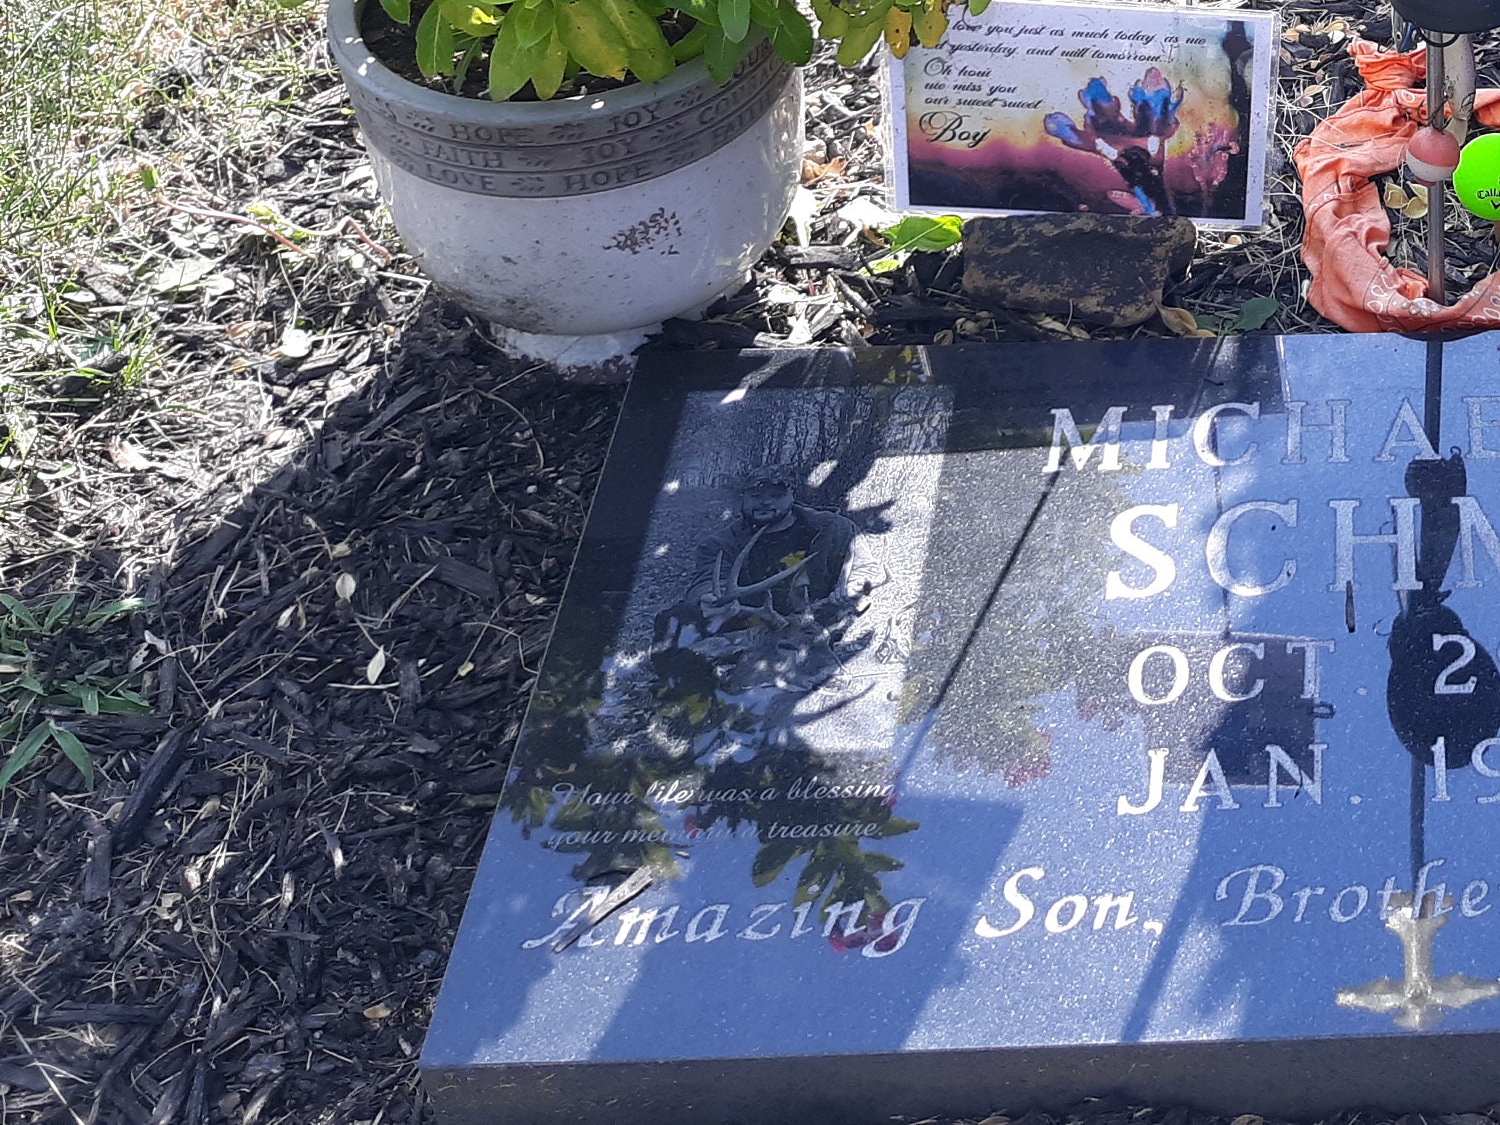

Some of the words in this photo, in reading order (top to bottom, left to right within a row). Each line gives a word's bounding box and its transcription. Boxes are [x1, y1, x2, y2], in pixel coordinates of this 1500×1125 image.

[985, 24, 1014, 36] you
[1012, 25, 1047, 37] just
[1049, 27, 1064, 37] as
[1071, 28, 1110, 40] much
[1163, 36, 1180, 44] as
[1185, 37, 1207, 45] we
[923, 57, 952, 76] Oh
[958, 66, 993, 77] how
[1026, 45, 1060, 56] and
[1060, 47, 1090, 58] will
[924, 82, 946, 90] we
[953, 81, 982, 92] miss
[986, 85, 1019, 96] you
[924, 96, 949, 105] our
[955, 97, 997, 108] sweet
[1000, 99, 1043, 110] sweet
[449, 124, 536, 144] HOPE
[606, 99, 666, 134] JOY
[918, 110, 992, 149] Boy
[418, 138, 504, 168] FAITH
[581, 133, 642, 165] JOY
[426, 163, 497, 191] LOVE
[564, 160, 655, 192] HOPE
[1127, 639, 1368, 705] OCT.
[1117, 742, 1363, 817] JAN.
[551, 781, 636, 815] Your
[644, 778, 695, 807] life
[698, 787, 757, 803] was
[760, 787, 781, 801] a
[547, 829, 620, 852] your
[767, 821, 884, 841] treasure.
[521, 883, 927, 958] Amazing
[974, 865, 1164, 938] Son,
